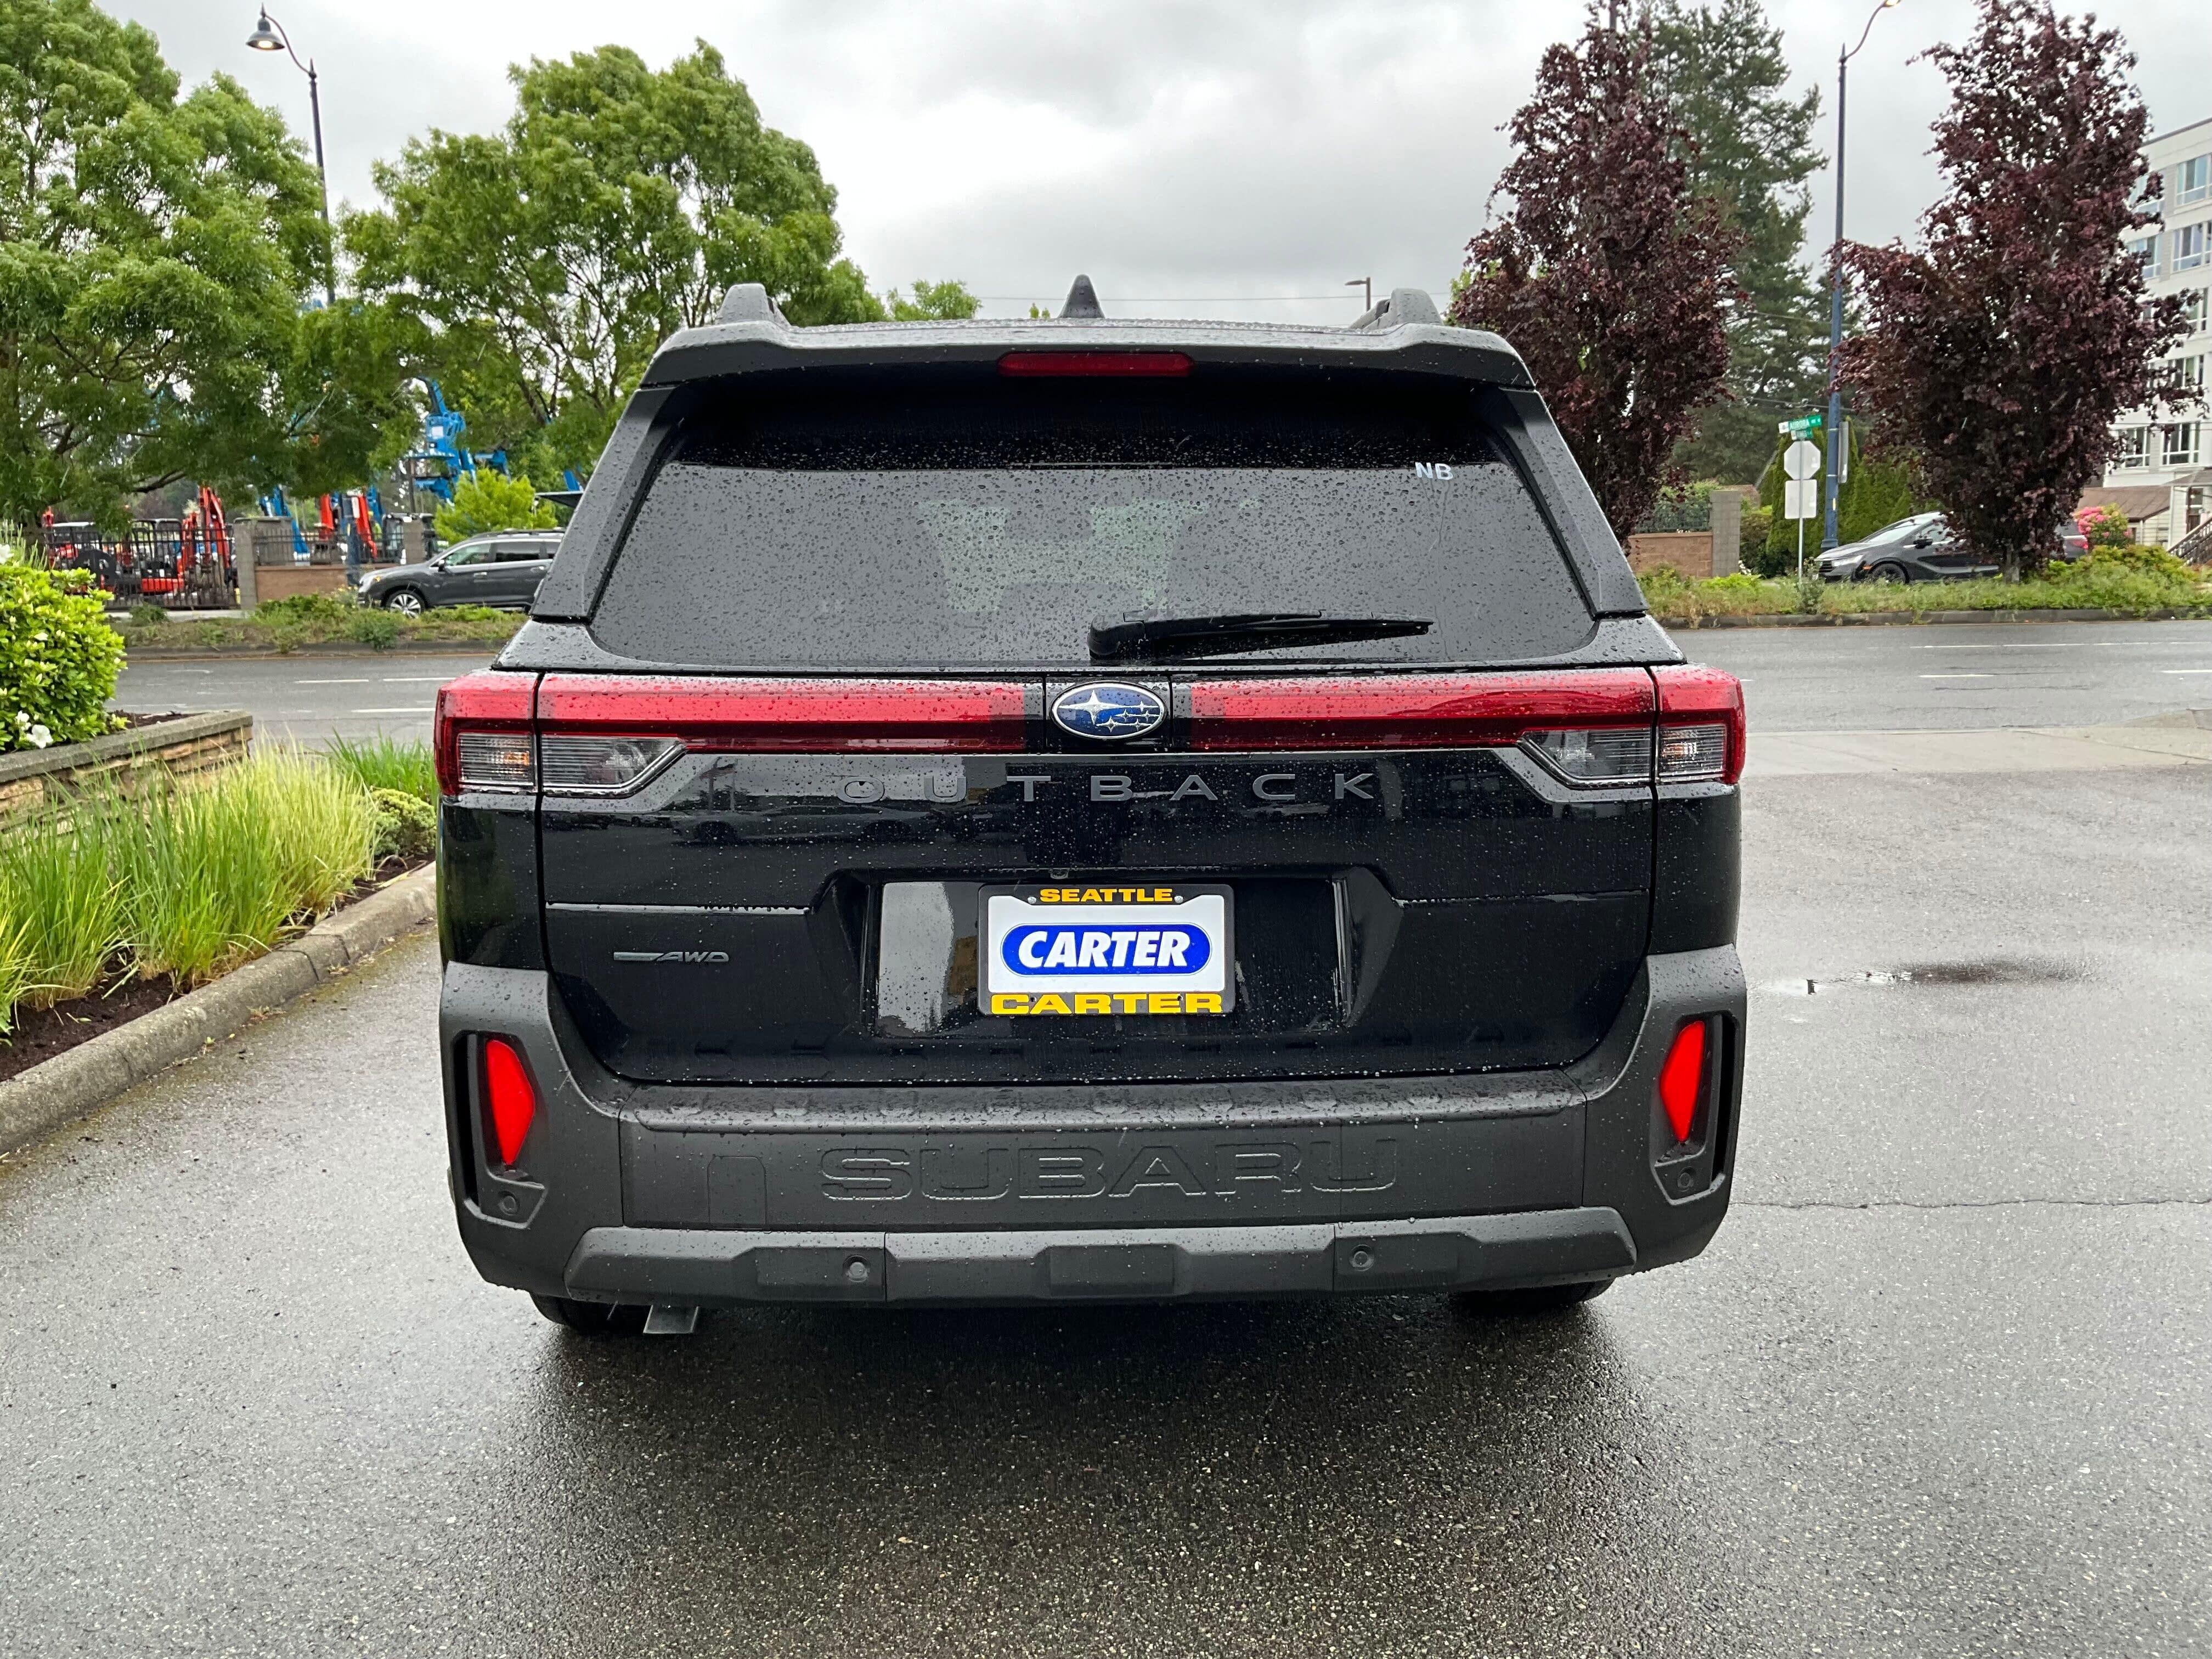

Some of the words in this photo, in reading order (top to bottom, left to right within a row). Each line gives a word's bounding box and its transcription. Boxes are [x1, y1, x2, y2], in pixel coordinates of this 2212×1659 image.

[1790, 419, 1810, 430] AURORA
[1415, 461, 1453, 480] NB
[836, 773, 1374, 804] OUTBACK
[1040, 888, 1173, 902] SEATTLE
[656, 951, 729, 963] AWD
[1018, 930, 1190, 968] CARTER
[990, 993, 1222, 1014] CARTER
[820, 1138, 1398, 1201] SUBARU
